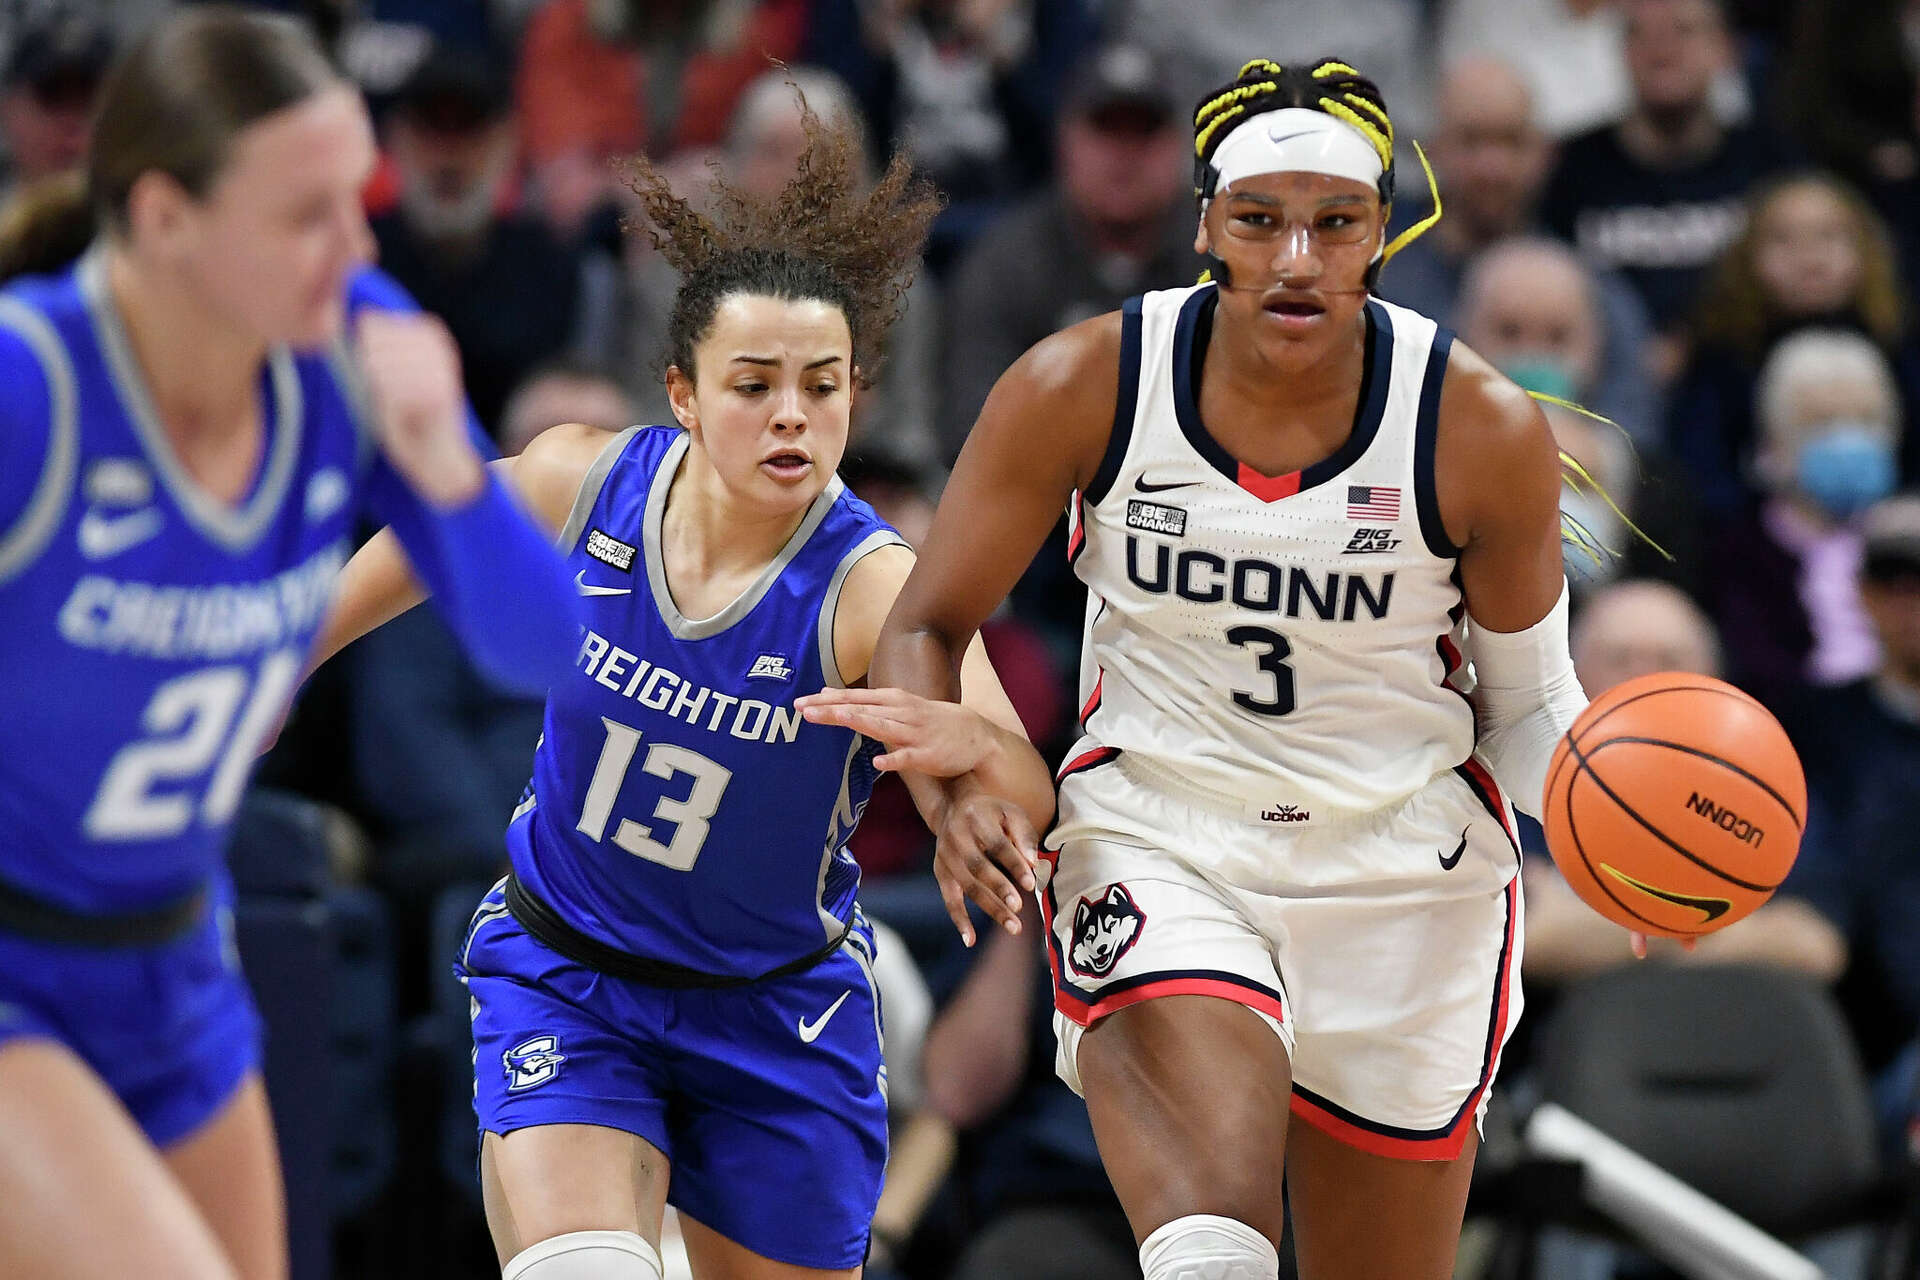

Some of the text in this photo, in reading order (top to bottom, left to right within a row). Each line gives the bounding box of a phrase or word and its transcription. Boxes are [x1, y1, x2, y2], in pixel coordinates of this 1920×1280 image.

[1128, 515, 1183, 533] CHANGE
[1353, 528, 1393, 540] BIG
[586, 542, 631, 569] CHANGE
[1345, 539, 1403, 551] EAST
[1126, 534, 1397, 622] UCONN
[750, 664, 792, 677] EAST
[755, 655, 786, 667] BIG
[1223, 624, 1297, 718] 3
[575, 623, 802, 744] REIGHTON
[82, 648, 300, 842] 21
[576, 715, 734, 873] 13
[1261, 810, 1310, 822] UCONN
[1686, 791, 1764, 849] UCONN
